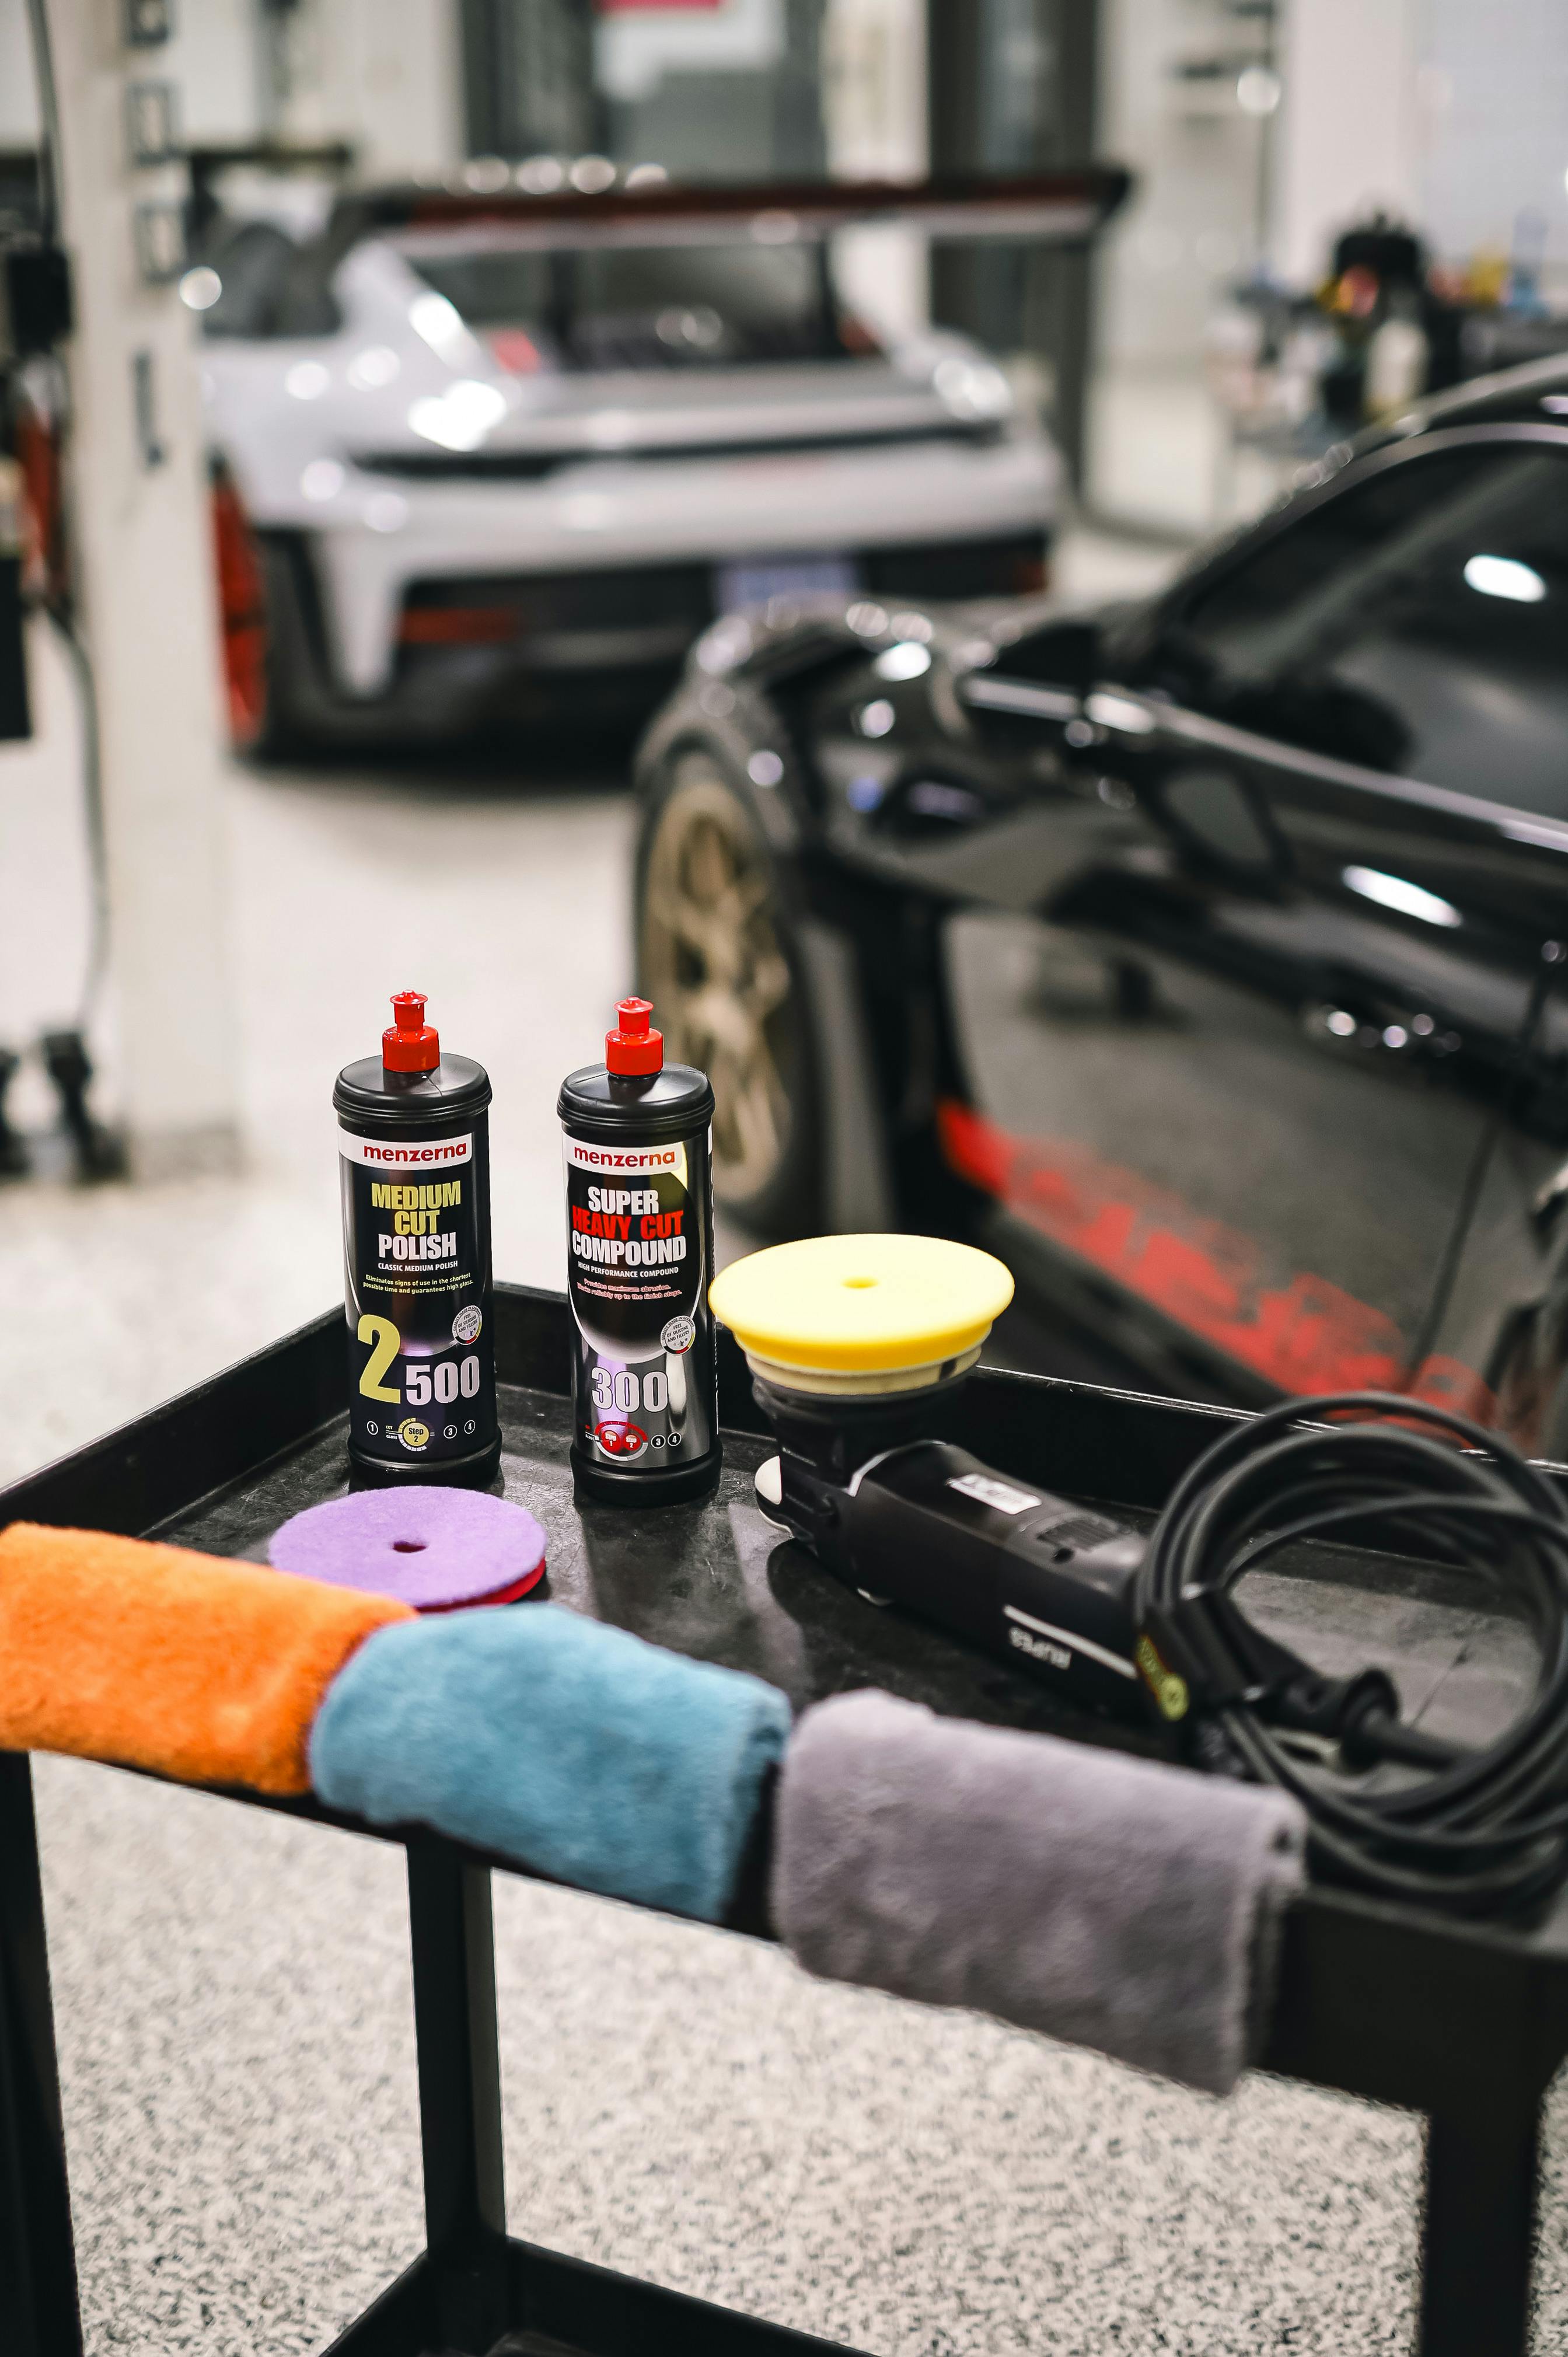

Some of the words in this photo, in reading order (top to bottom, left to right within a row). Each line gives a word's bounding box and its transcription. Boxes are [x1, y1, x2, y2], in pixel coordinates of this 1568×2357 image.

[364, 1143, 467, 1162] menzerna
[574, 1146, 675, 1167] menzerna
[371, 1181, 461, 1210] MEDIUM
[588, 1186, 659, 1215] SUPER
[394, 1210, 440, 1235] CUT
[572, 1205, 631, 1240] HEAVY
[640, 1210, 684, 1239] CUT
[378, 1232, 456, 1260] POLISH
[572, 1230, 686, 1266] COMPOUND
[378, 1262, 403, 1272] CLASSIC
[435, 1260, 458, 1270] POLISH
[578, 1261, 590, 1272] HIGH
[591, 1266, 638, 1277] PERFORMANCE
[640, 1267, 679, 1277] COMPOUND
[365, 1274, 394, 1285] Eliminates
[449, 1272, 470, 1283] shortest
[584, 1278, 607, 1290] Provides
[640, 1284, 671, 1293] abrasion.
[363, 1281, 384, 1291] possible
[411, 1287, 446, 1295] guarantees
[591, 1289, 613, 1300] reliably
[644, 1291, 663, 1300] finish
[663, 1290, 682, 1298] stage.
[672, 1325, 689, 1336] SILICONE
[676, 1330, 690, 1339] FILLERS
[591, 1367, 669, 1413] 300
[408, 1427, 424, 1436] Step
